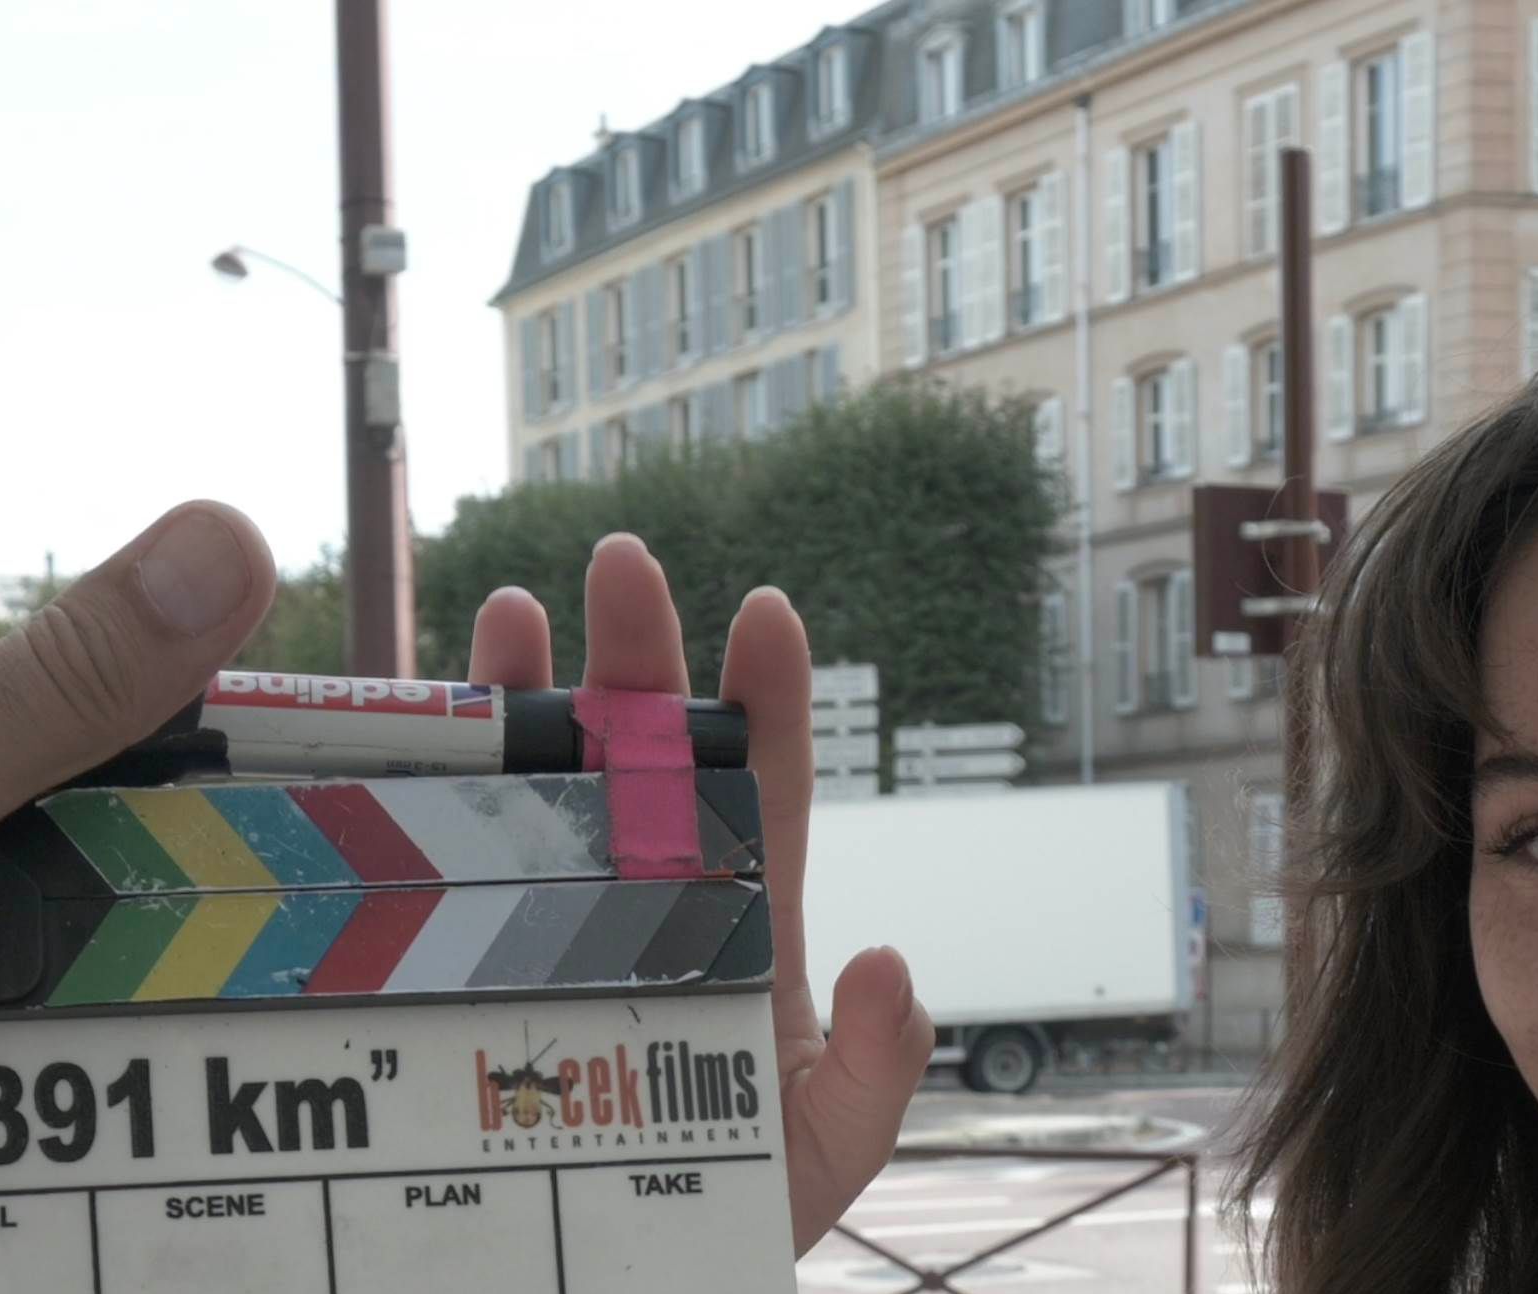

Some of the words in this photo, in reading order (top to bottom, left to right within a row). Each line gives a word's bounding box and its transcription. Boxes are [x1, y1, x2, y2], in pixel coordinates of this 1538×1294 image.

[482, 1126, 761, 1153] ENTERTAINMENT
[405, 1183, 481, 1207] PLAN
[629, 1172, 703, 1197] TAKE
[165, 1194, 266, 1219] SCENE
